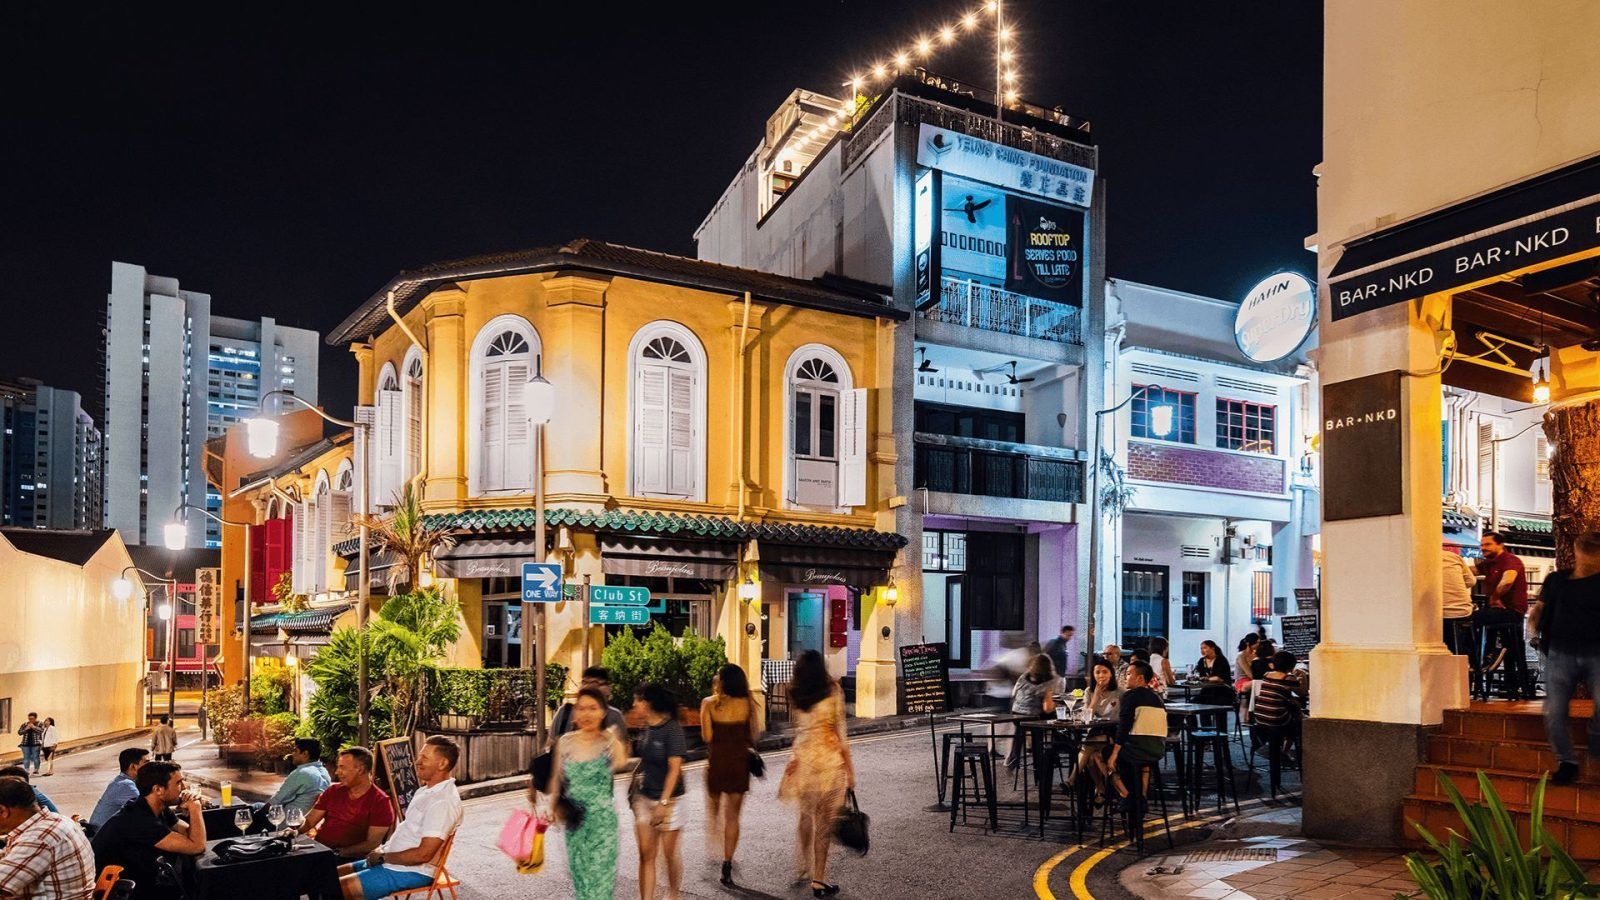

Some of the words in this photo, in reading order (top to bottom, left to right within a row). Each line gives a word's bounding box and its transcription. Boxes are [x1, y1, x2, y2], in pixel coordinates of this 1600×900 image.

[1030, 232, 1070, 246] ROOFTOP
[1025, 248, 1055, 261] SERVES
[1056, 249, 1077, 262] FOOD
[1035, 263, 1050, 276] TILL
[1051, 263, 1071, 276] LATE
[1248, 280, 1290, 311] HAHN
[803, 568, 847, 583] Beaujolais
[525, 590, 541, 598] ONE
[544, 590, 558, 598] WAY
[594, 588, 624, 600] Club
[629, 590, 642, 601] St
[598, 610, 643, 621] 客纳街
